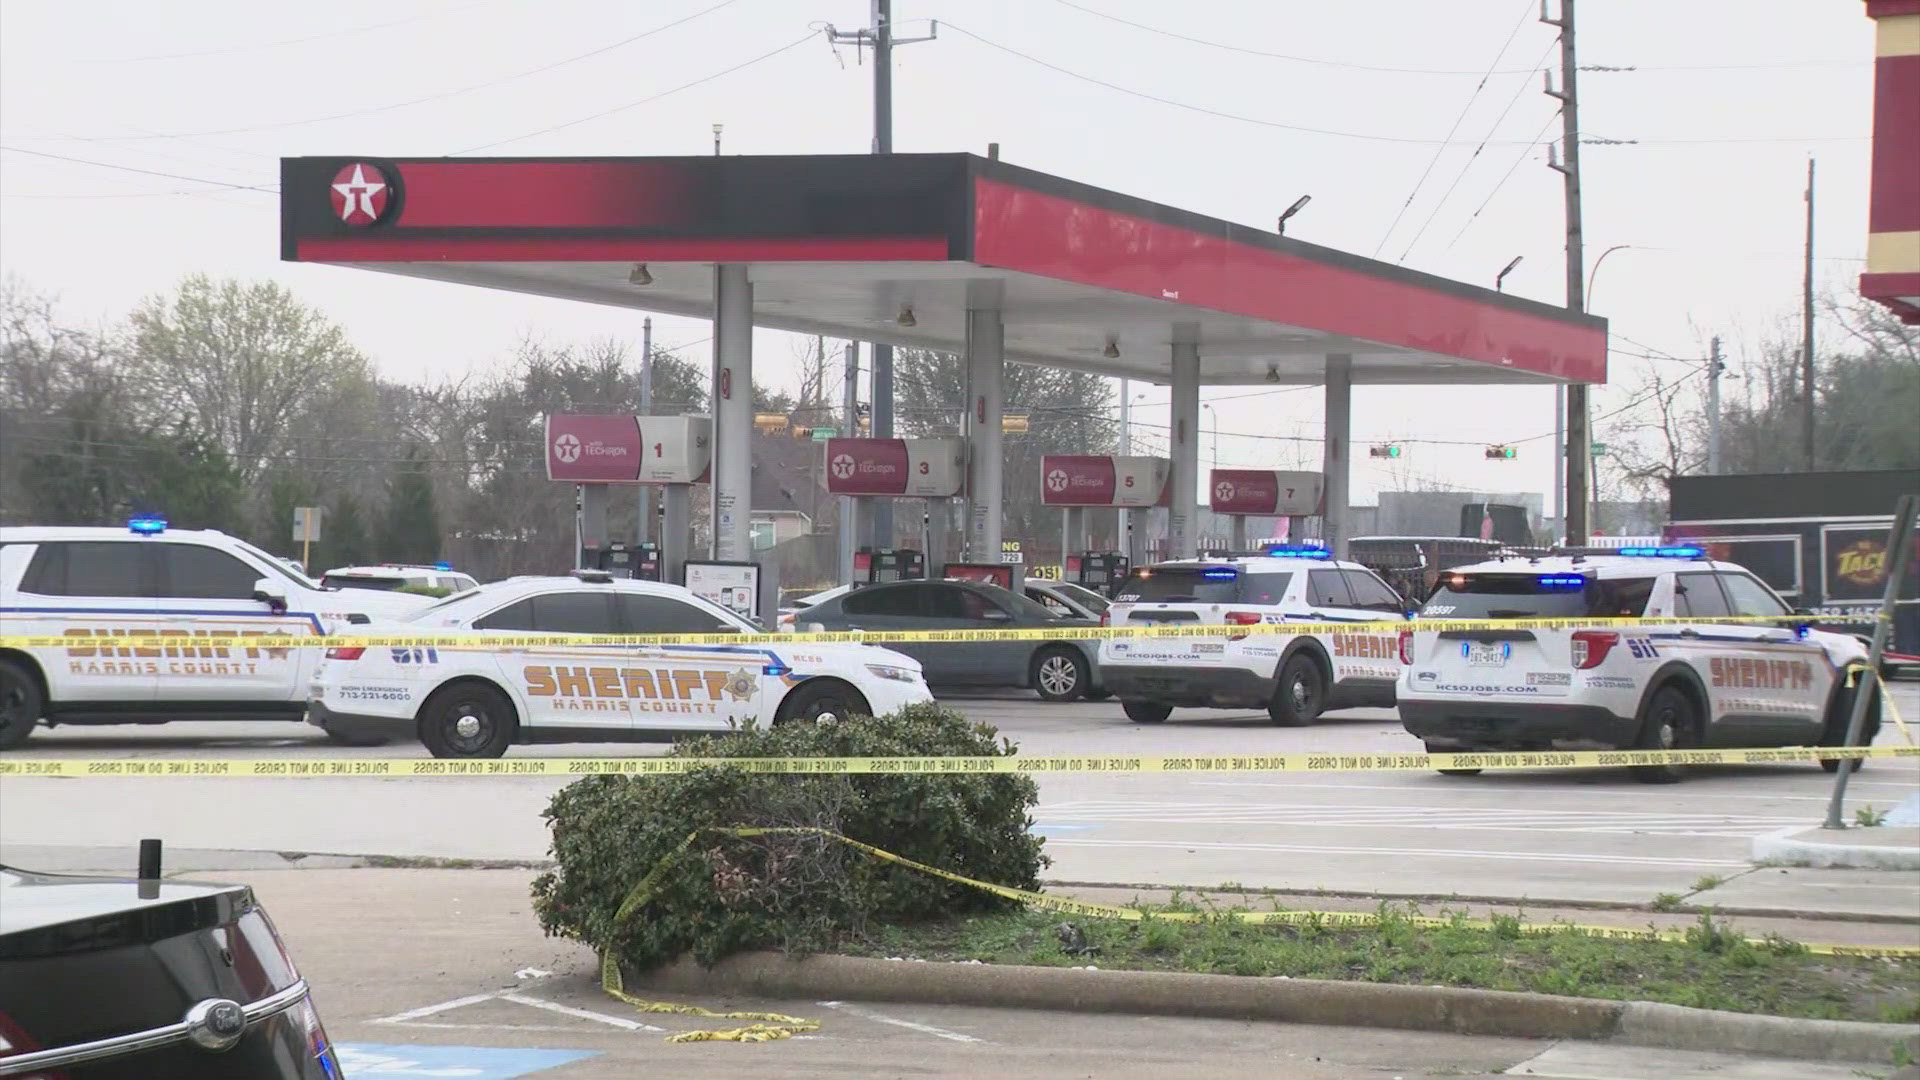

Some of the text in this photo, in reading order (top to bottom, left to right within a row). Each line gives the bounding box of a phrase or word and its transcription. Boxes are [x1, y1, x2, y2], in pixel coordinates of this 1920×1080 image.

[584, 445, 626, 456] TECHRON
[653, 443, 662, 457] 1
[919, 462, 929, 475] 3
[1125, 476, 1134, 487] 5
[1286, 489, 1295, 499] 7
[1424, 605, 1456, 615] 20597
[1627, 640, 1660, 658] 911
[69, 662, 257, 674] HARRIS COUNTY
[523, 665, 730, 700] SHERIFF
[1436, 684, 1538, 693] HCSOJOBS.COM
[340, 692, 411, 701] 713-221-6000
[553, 698, 717, 714] HARRIS COUNTY
[216, 1007, 239, 1031] Ford
